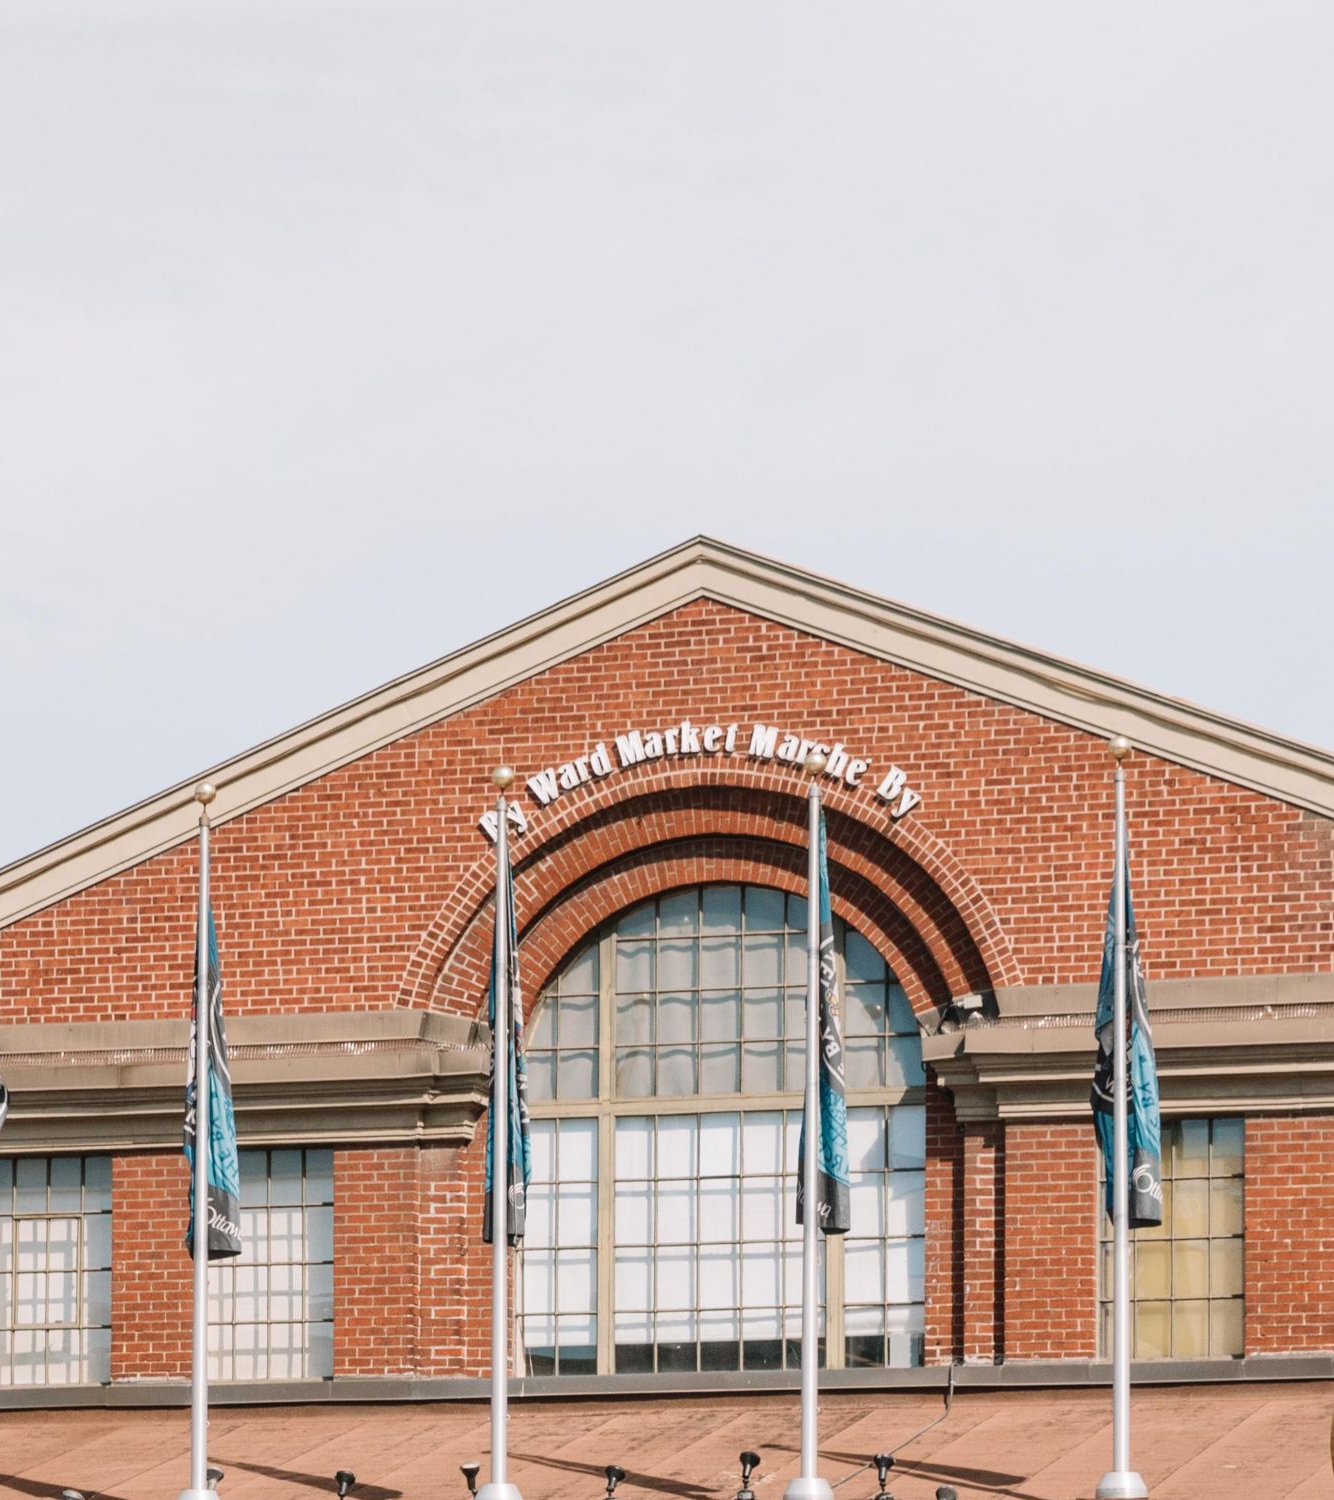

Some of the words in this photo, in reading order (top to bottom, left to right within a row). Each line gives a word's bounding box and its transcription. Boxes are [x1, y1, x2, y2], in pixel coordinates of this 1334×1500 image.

[527, 742, 613, 805] Ward
[614, 720, 738, 768] Market
[876, 764, 922, 818] By
